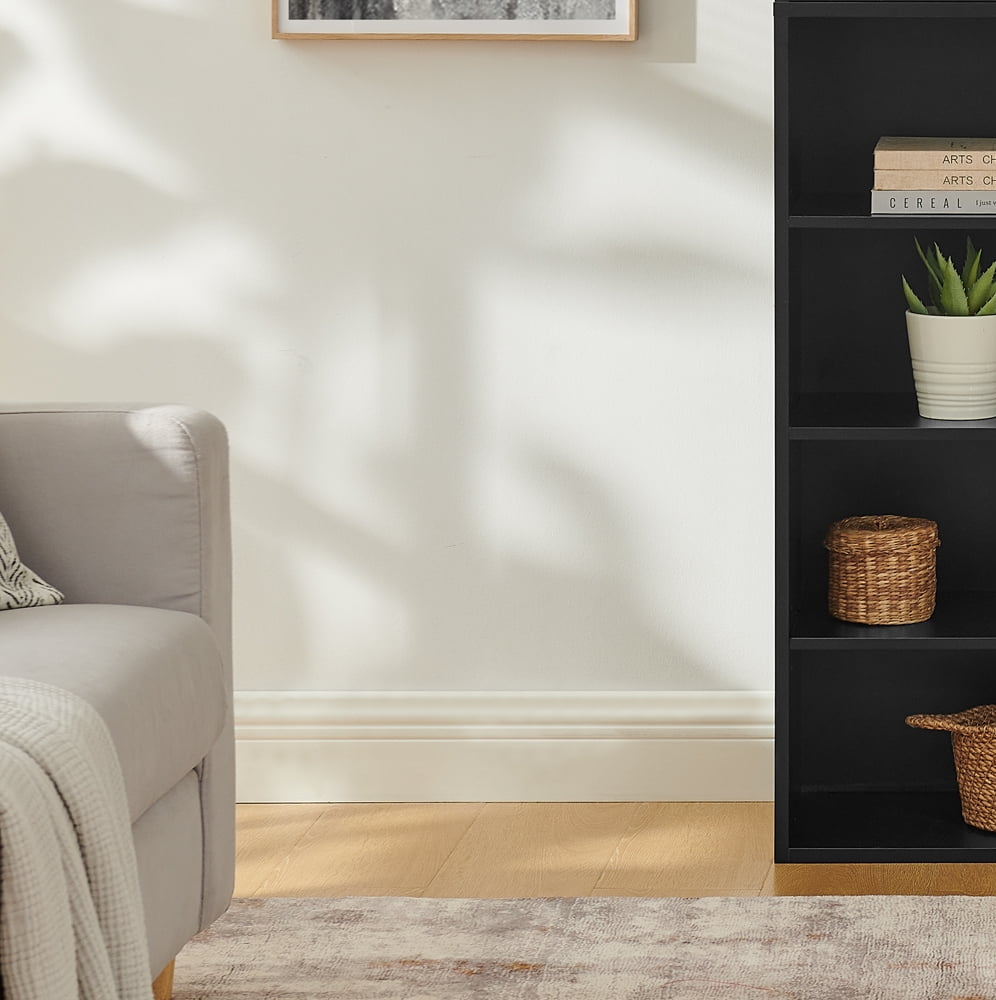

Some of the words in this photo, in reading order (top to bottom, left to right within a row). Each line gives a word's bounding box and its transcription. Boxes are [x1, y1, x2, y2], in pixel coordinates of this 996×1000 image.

[942, 154, 973, 164] ARTS
[943, 175, 974, 186] ARTS
[889, 197, 963, 209] CEREAL
[979, 199, 991, 207] just
